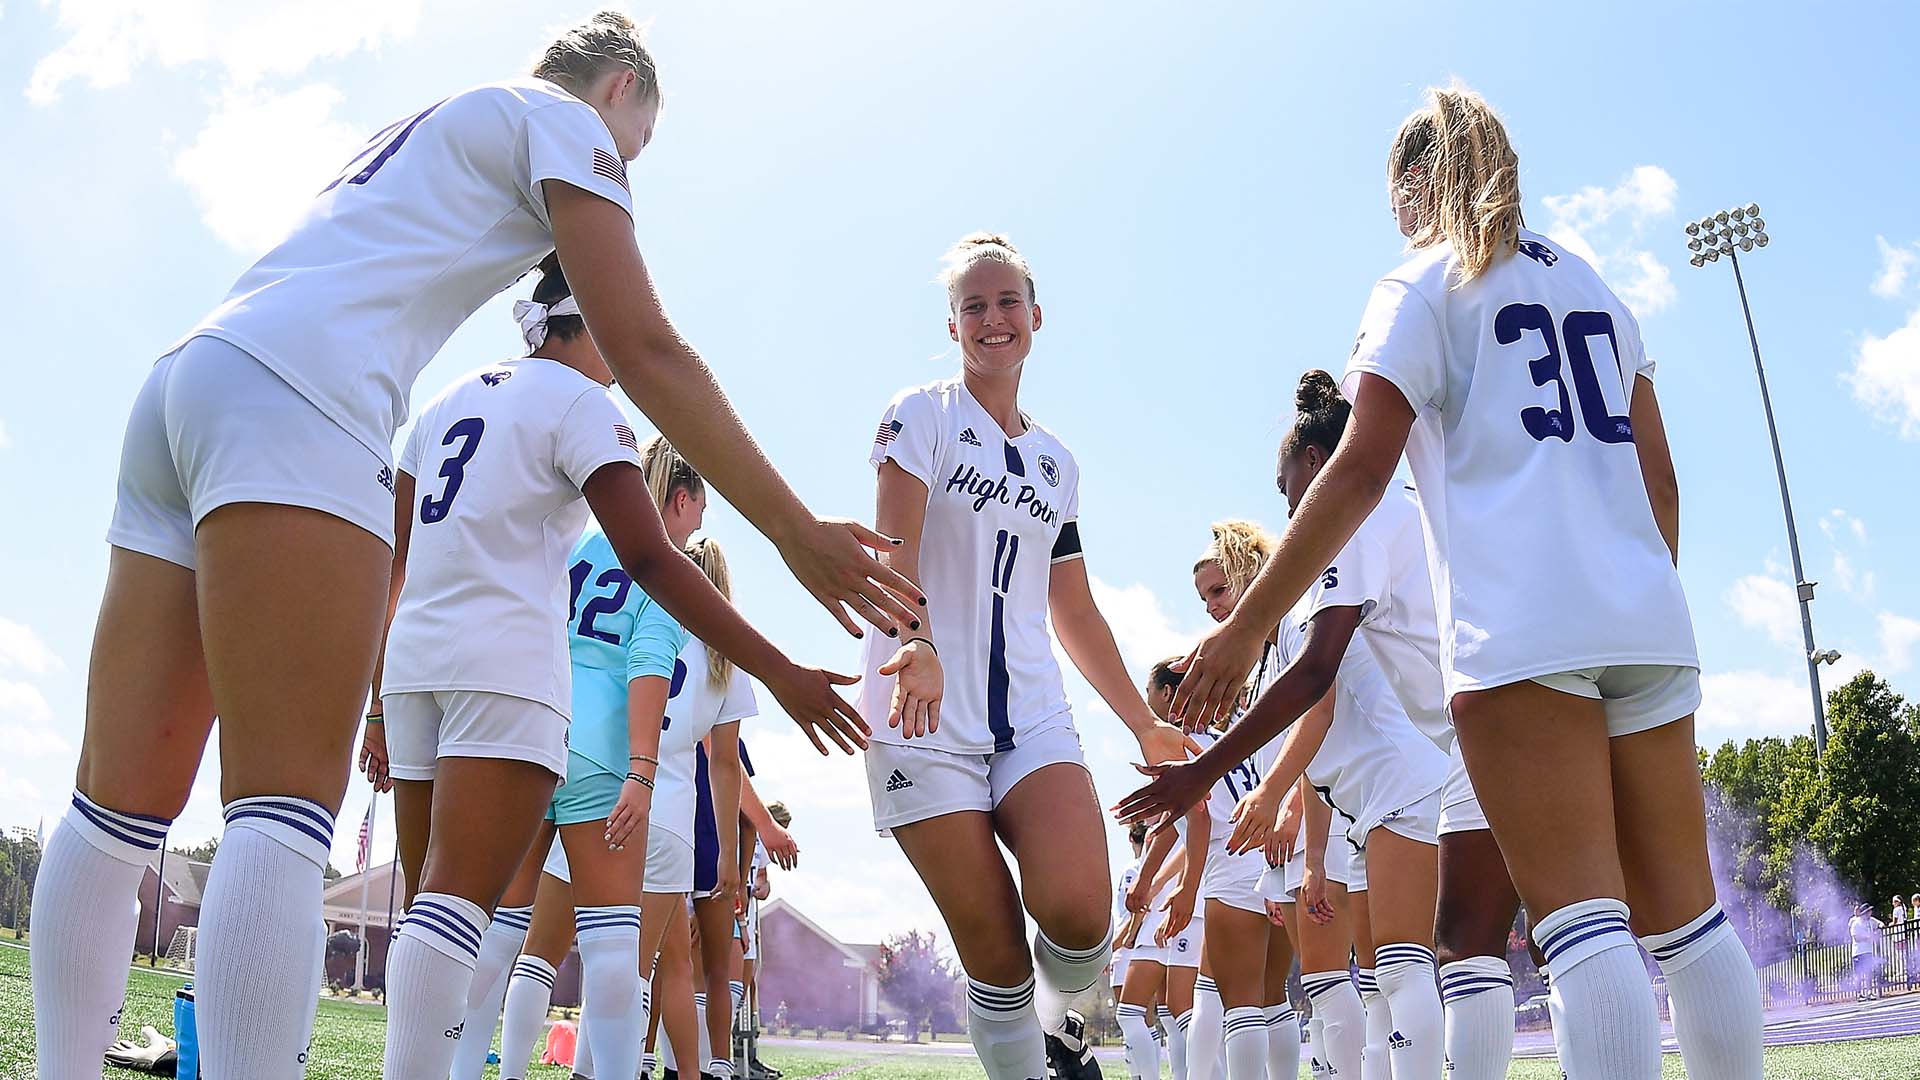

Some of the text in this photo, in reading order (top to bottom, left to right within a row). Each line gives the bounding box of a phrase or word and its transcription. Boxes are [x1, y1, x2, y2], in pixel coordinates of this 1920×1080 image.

[1494, 303, 1636, 443] 30
[420, 417, 485, 524] 3
[946, 463, 1010, 513] High
[992, 529, 1019, 593] 11
